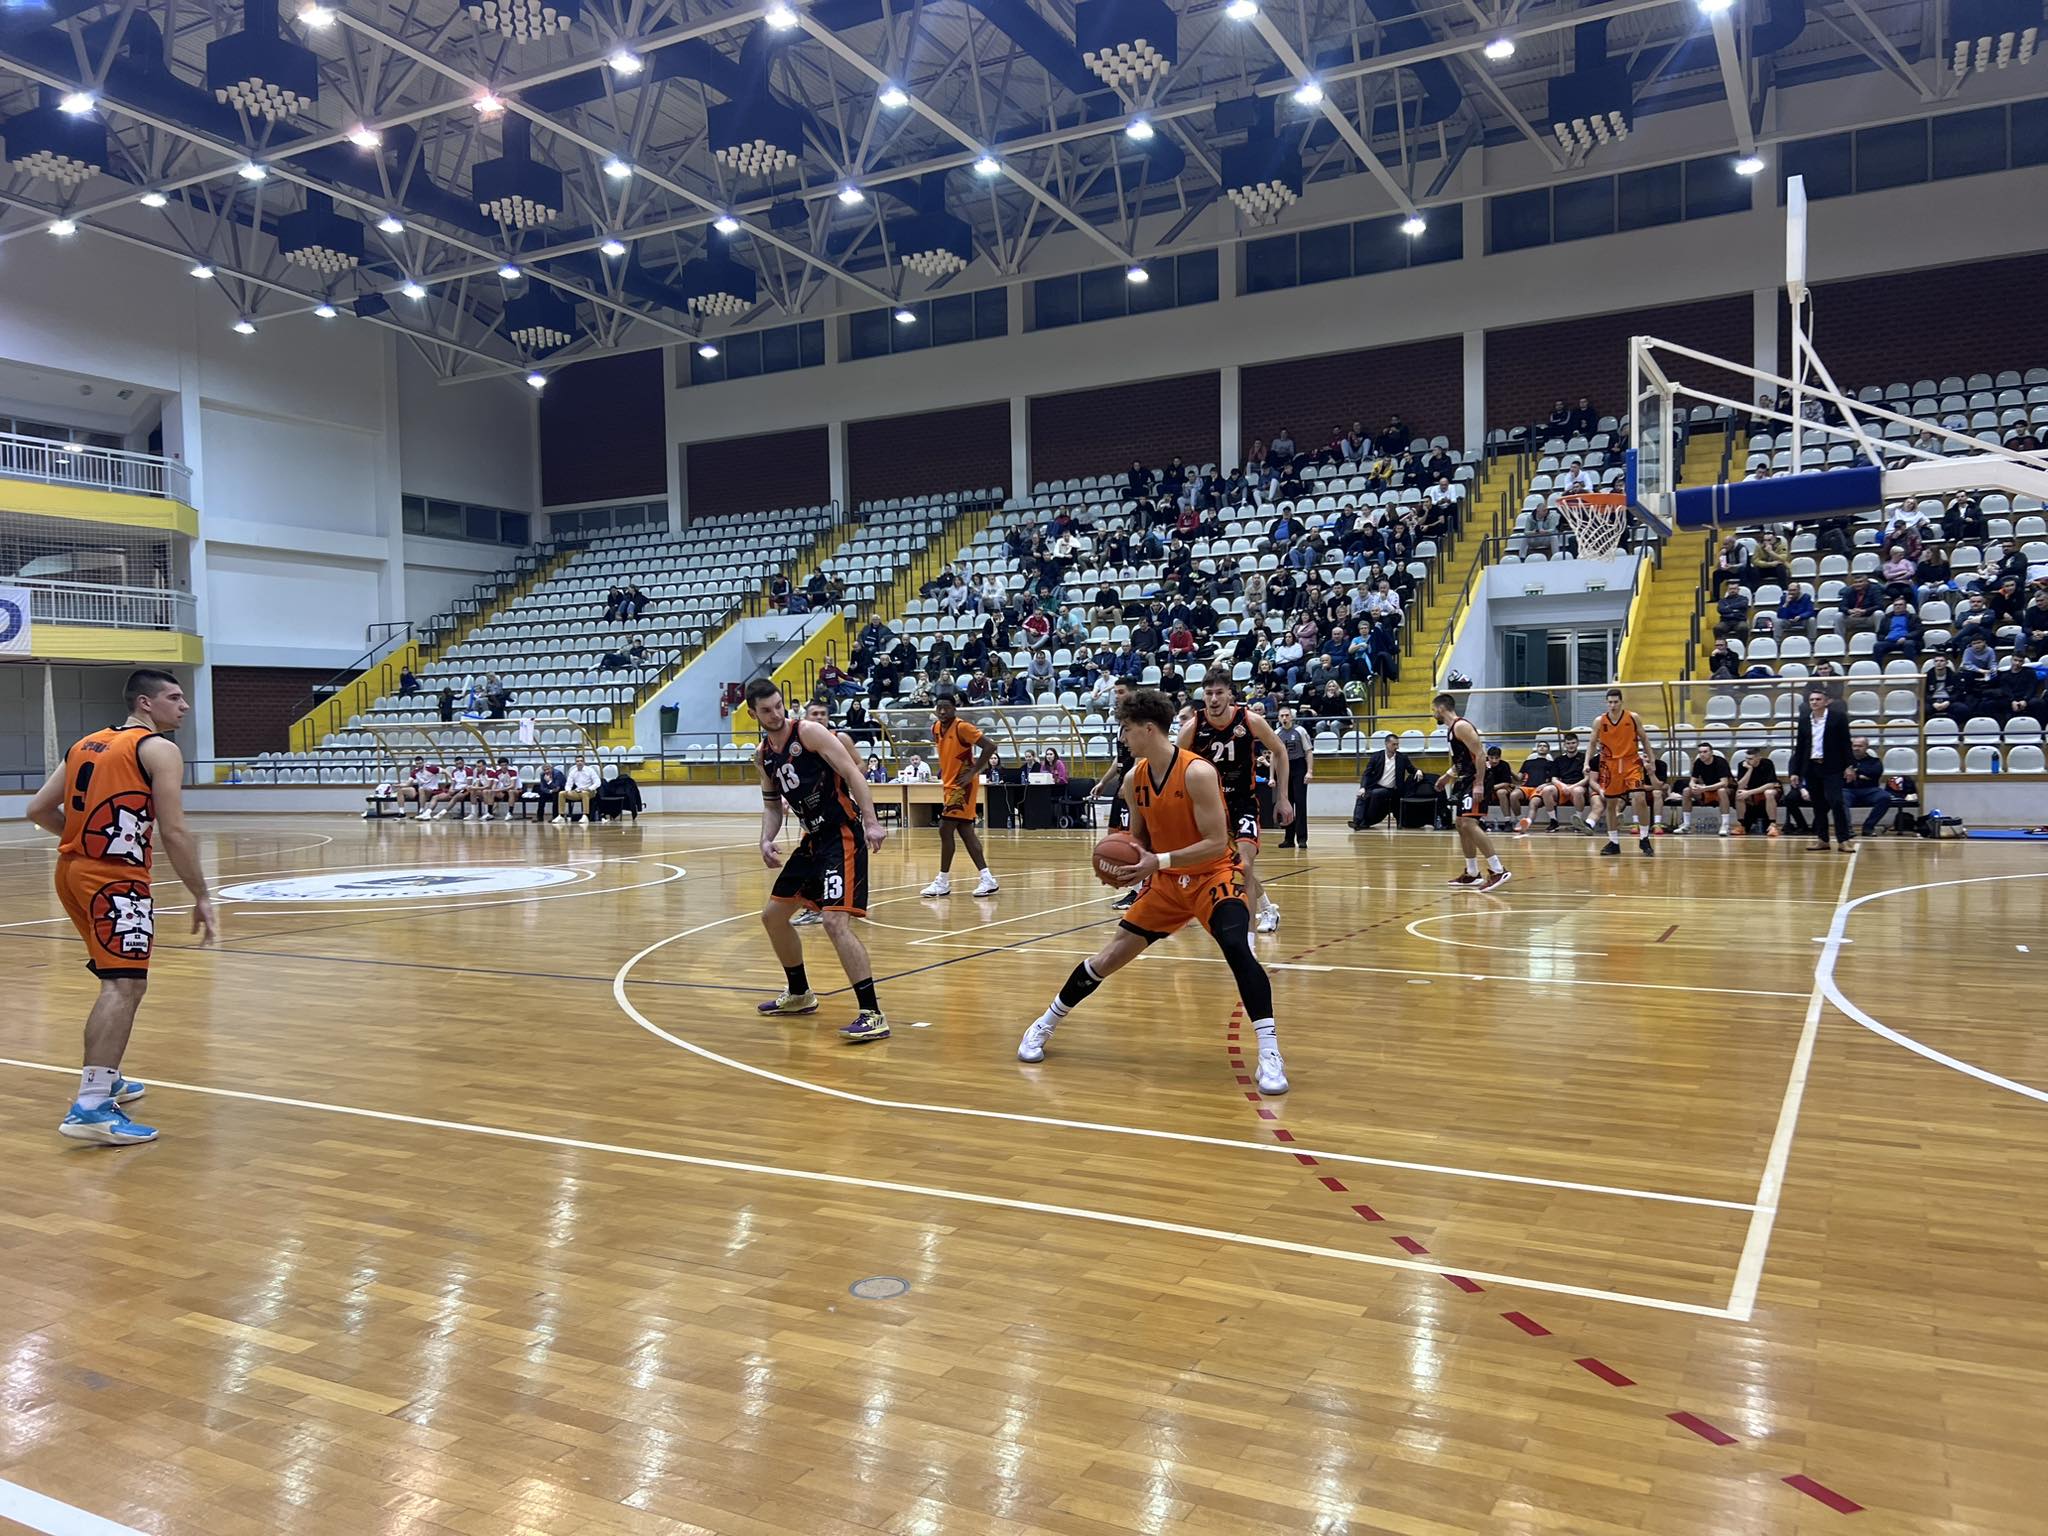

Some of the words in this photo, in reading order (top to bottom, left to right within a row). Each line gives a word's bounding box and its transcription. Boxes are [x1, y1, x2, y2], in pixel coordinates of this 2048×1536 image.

[1211, 740, 1235, 763] 21
[72, 761, 95, 812] 9
[776, 763, 800, 793] 13
[1135, 785, 1150, 807] 21
[1238, 817, 1258, 837] 21
[1209, 882, 1229, 905] 21
